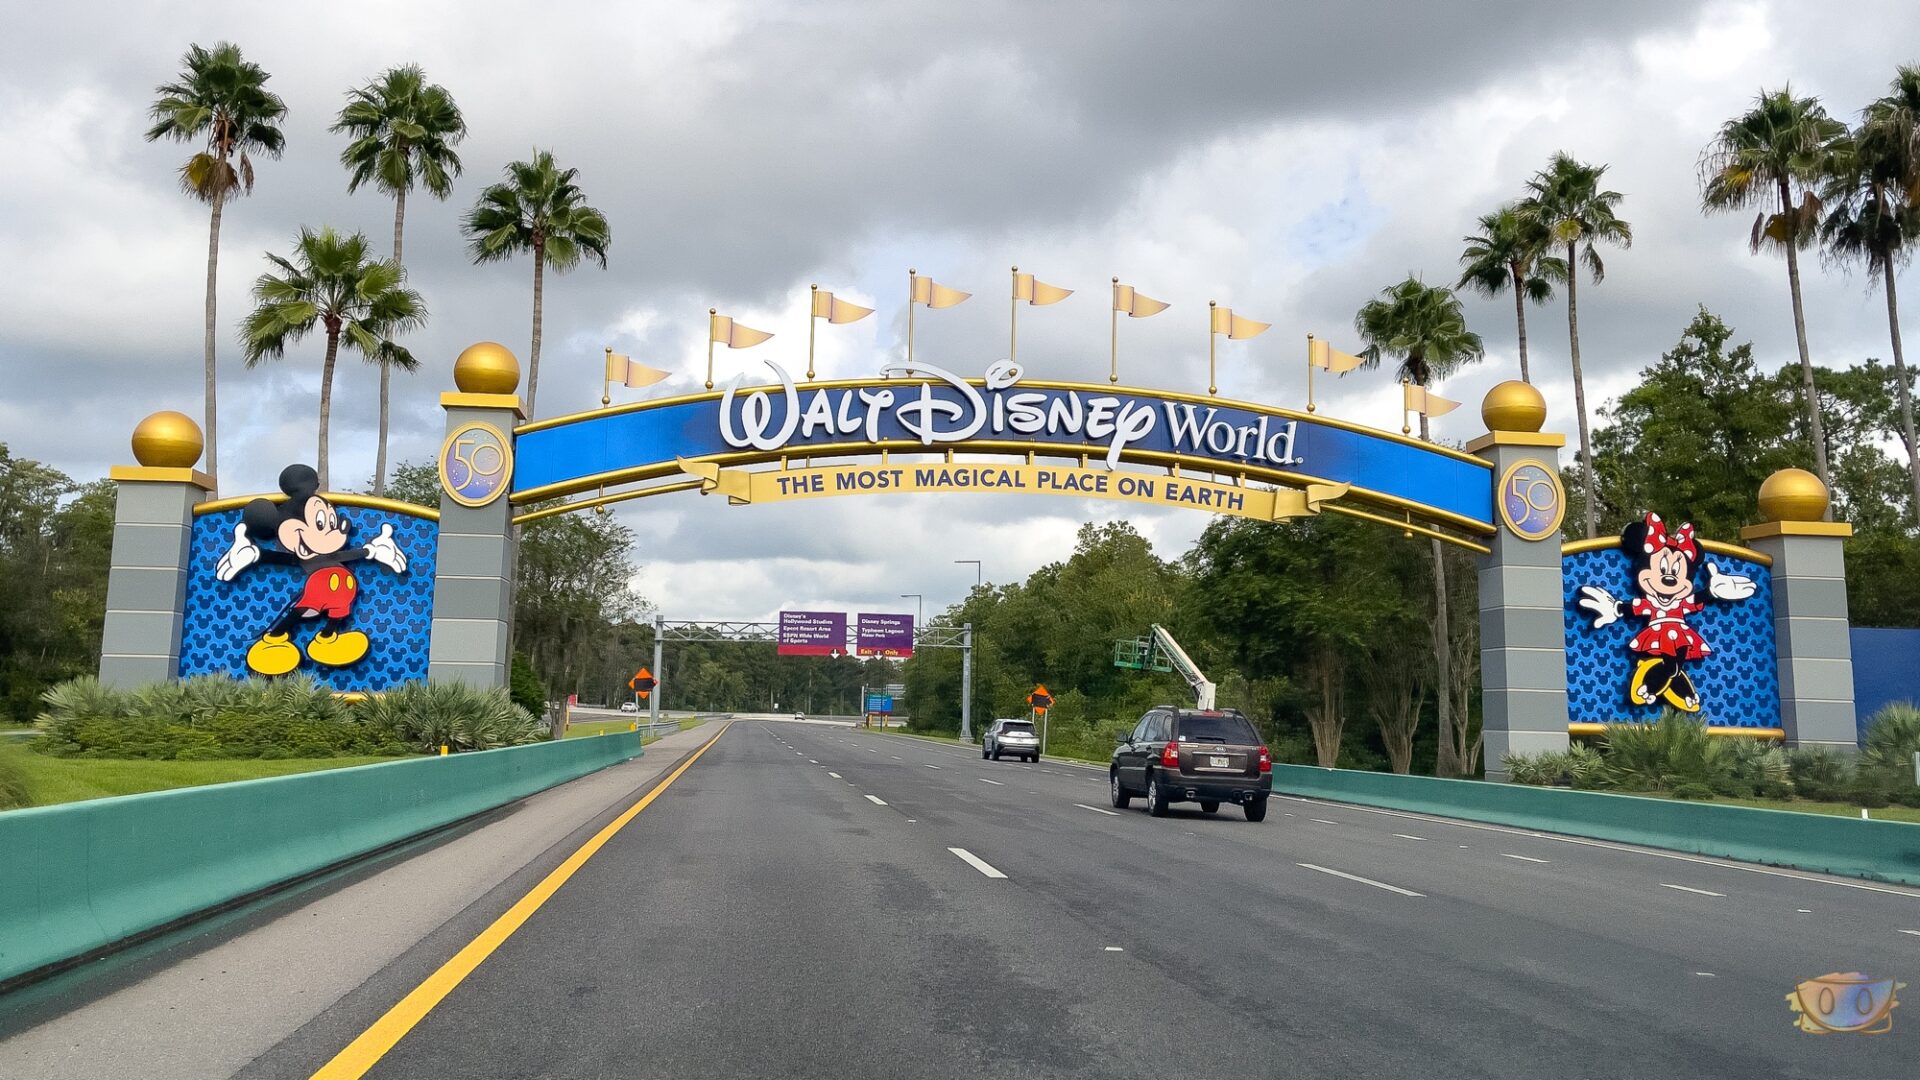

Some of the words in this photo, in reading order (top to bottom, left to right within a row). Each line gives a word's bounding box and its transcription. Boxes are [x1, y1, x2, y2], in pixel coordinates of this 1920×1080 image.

[454, 438, 504, 491] 50
[777, 474, 824, 495] THE
[836, 469, 904, 490] MOST
[915, 469, 1026, 488] MAGICAL
[1037, 471, 1108, 493] PLACE
[1118, 477, 1154, 498] ON
[1165, 483, 1244, 511] EARTH
[1511, 475, 1558, 525] 50
